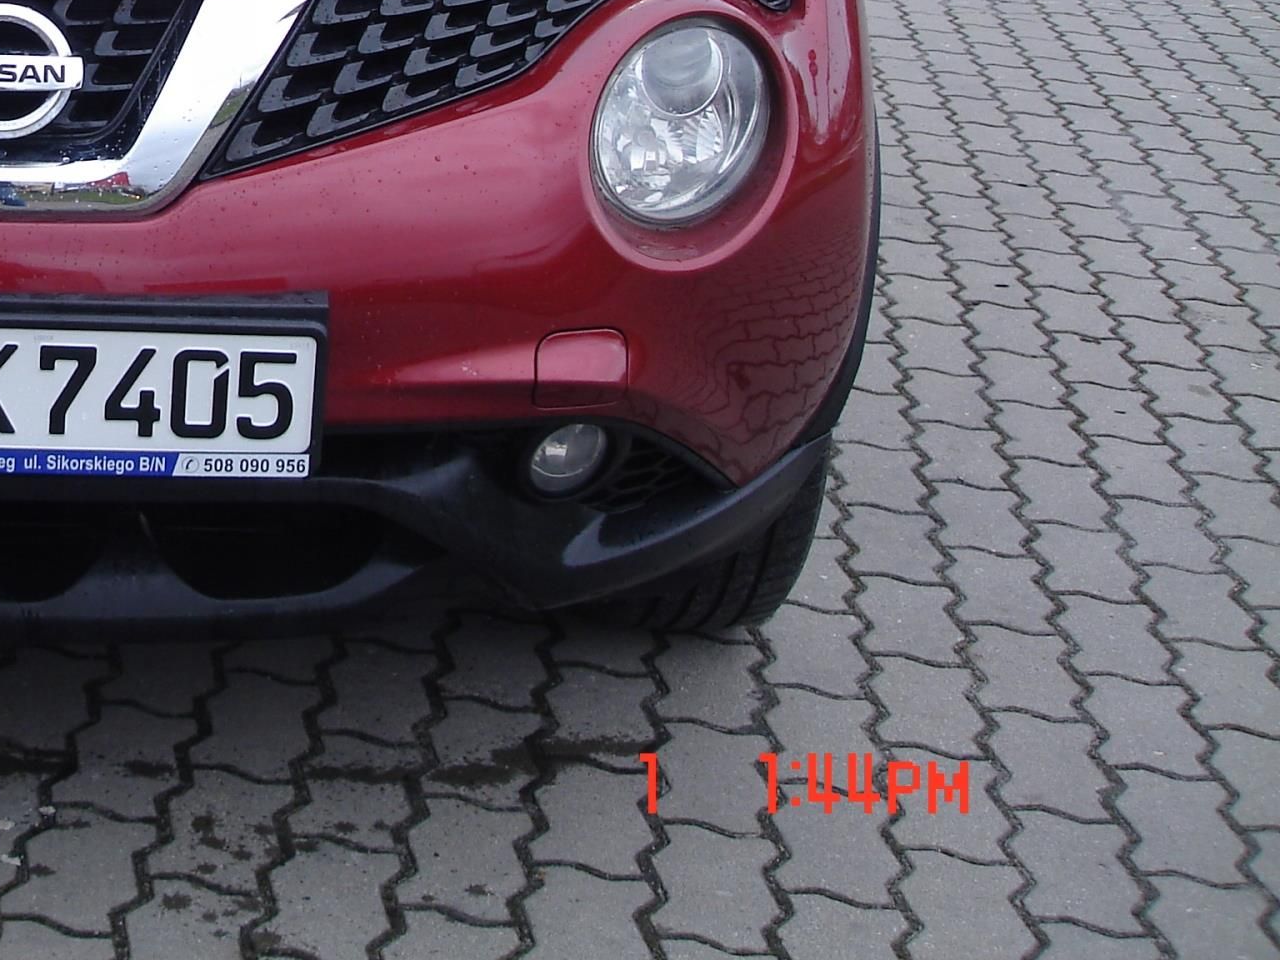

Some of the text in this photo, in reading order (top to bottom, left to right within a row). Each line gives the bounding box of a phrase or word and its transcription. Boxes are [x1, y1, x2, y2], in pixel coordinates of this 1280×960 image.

[24, 454, 42, 470] ul.
[46, 454, 135, 475] Sikorskiego
[139, 456, 166, 472] B/N
[203, 458, 306, 473] 508 090 956
